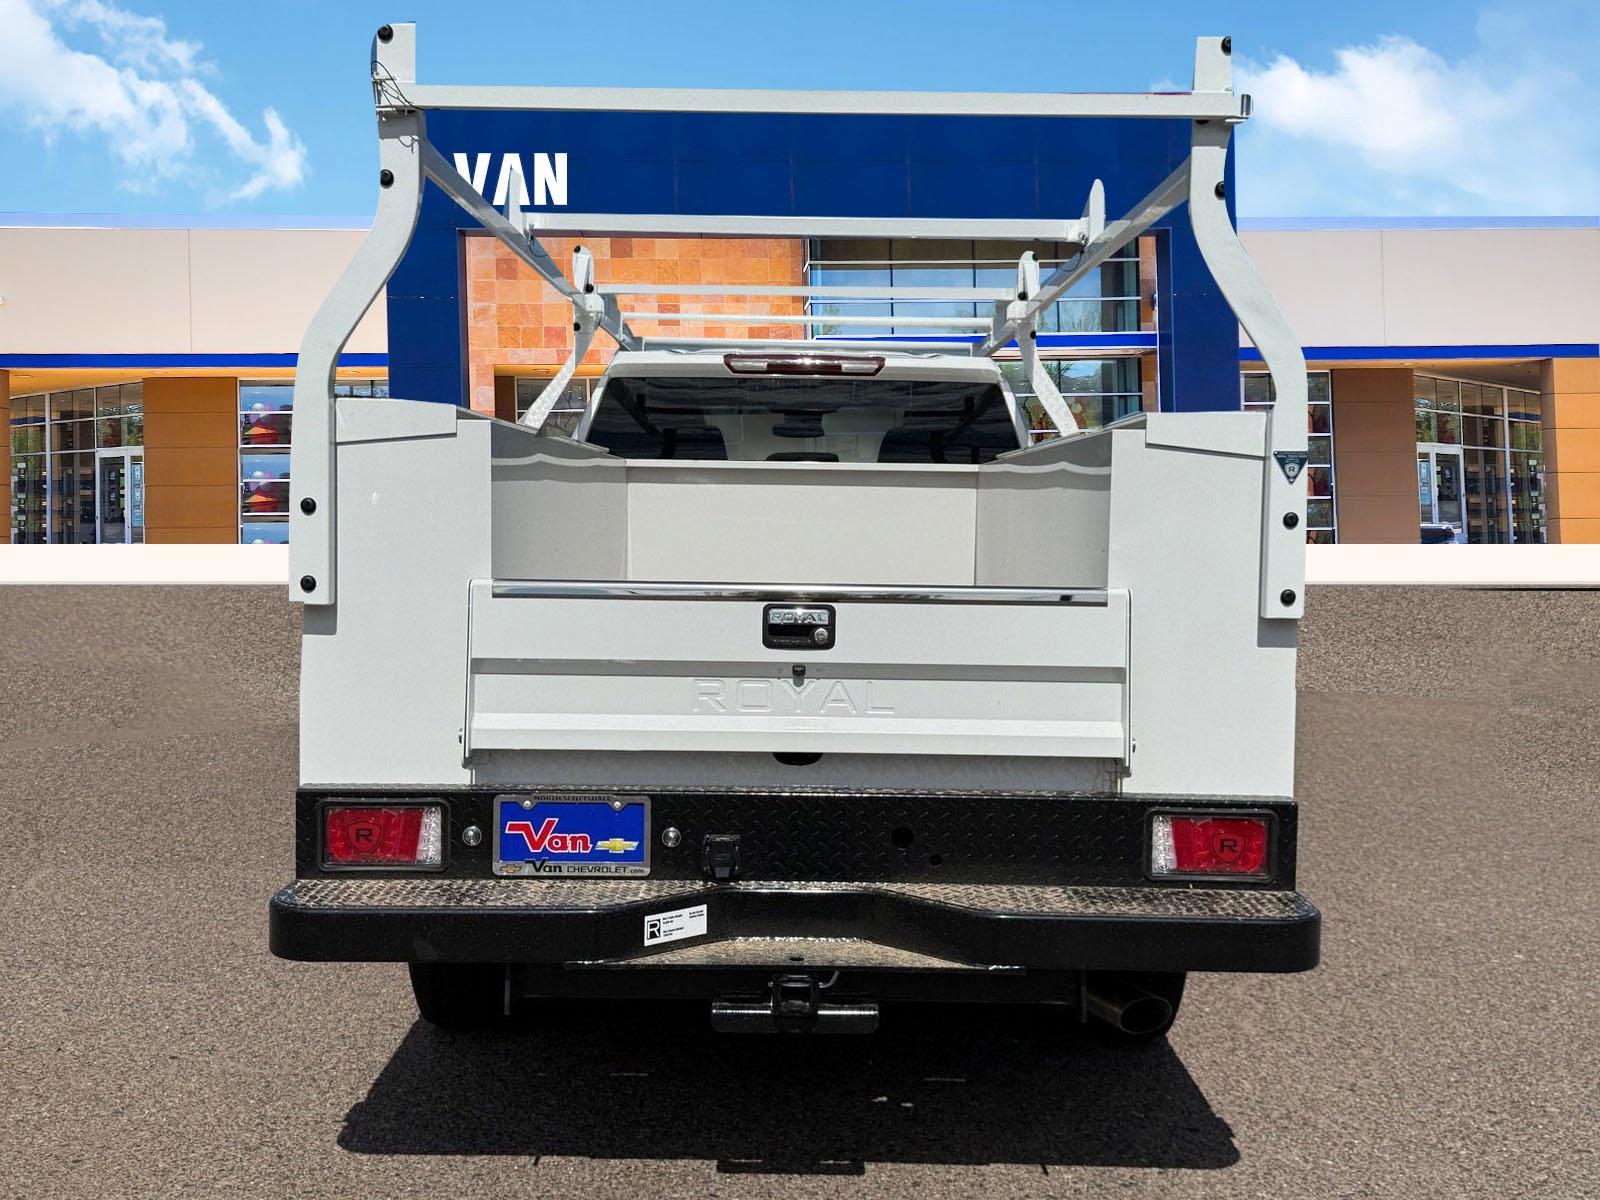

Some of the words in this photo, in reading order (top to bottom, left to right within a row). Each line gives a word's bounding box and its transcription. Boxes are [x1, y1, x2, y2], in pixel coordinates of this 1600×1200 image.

[453, 153, 567, 205] VAN
[772, 611, 826, 623] ROYAL
[692, 678, 895, 714] ROYAL
[356, 828, 372, 842] R
[505, 818, 592, 853] Van
[1220, 838, 1238, 853] R
[525, 857, 562, 873] Van
[647, 920, 660, 939] R
